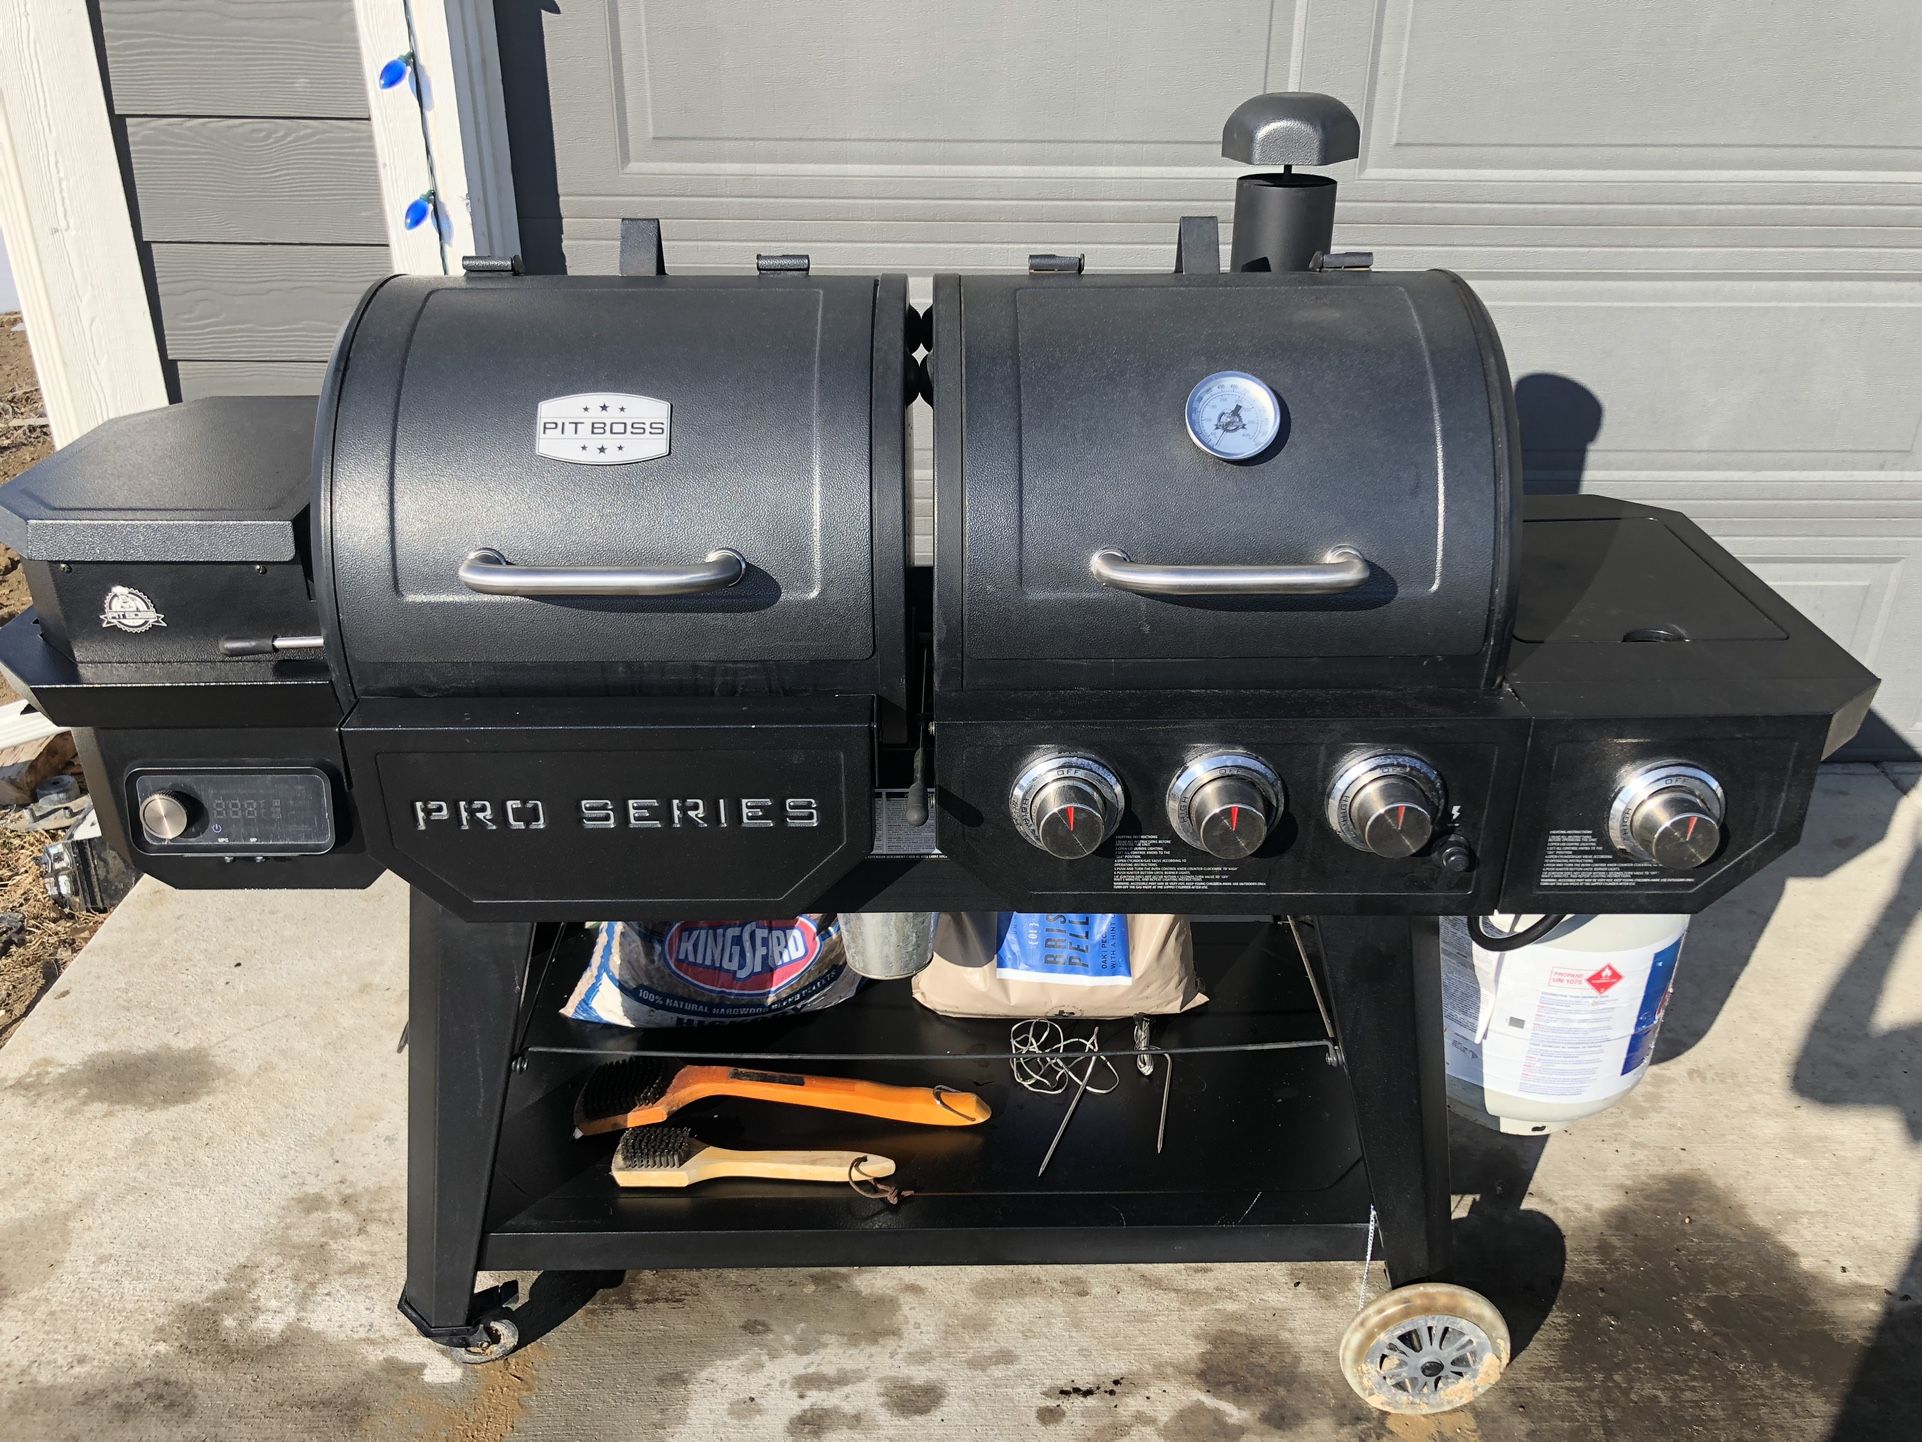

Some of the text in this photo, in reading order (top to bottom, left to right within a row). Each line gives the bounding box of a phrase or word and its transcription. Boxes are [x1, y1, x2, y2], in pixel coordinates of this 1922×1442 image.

[542, 421, 665, 435] PIT BOSS
[1056, 768, 1081, 776] OFF
[1664, 777, 1689, 785] OFF
[413, 797, 819, 830] PRO SERIES
[1179, 796, 1189, 824] HIGH
[1340, 795, 1351, 824] HIGH
[1621, 808, 1633, 837] HIGH
[1068, 915, 1090, 968] PELL
[638, 988, 664, 1005] 100%
[665, 997, 710, 1014] NATURAL
